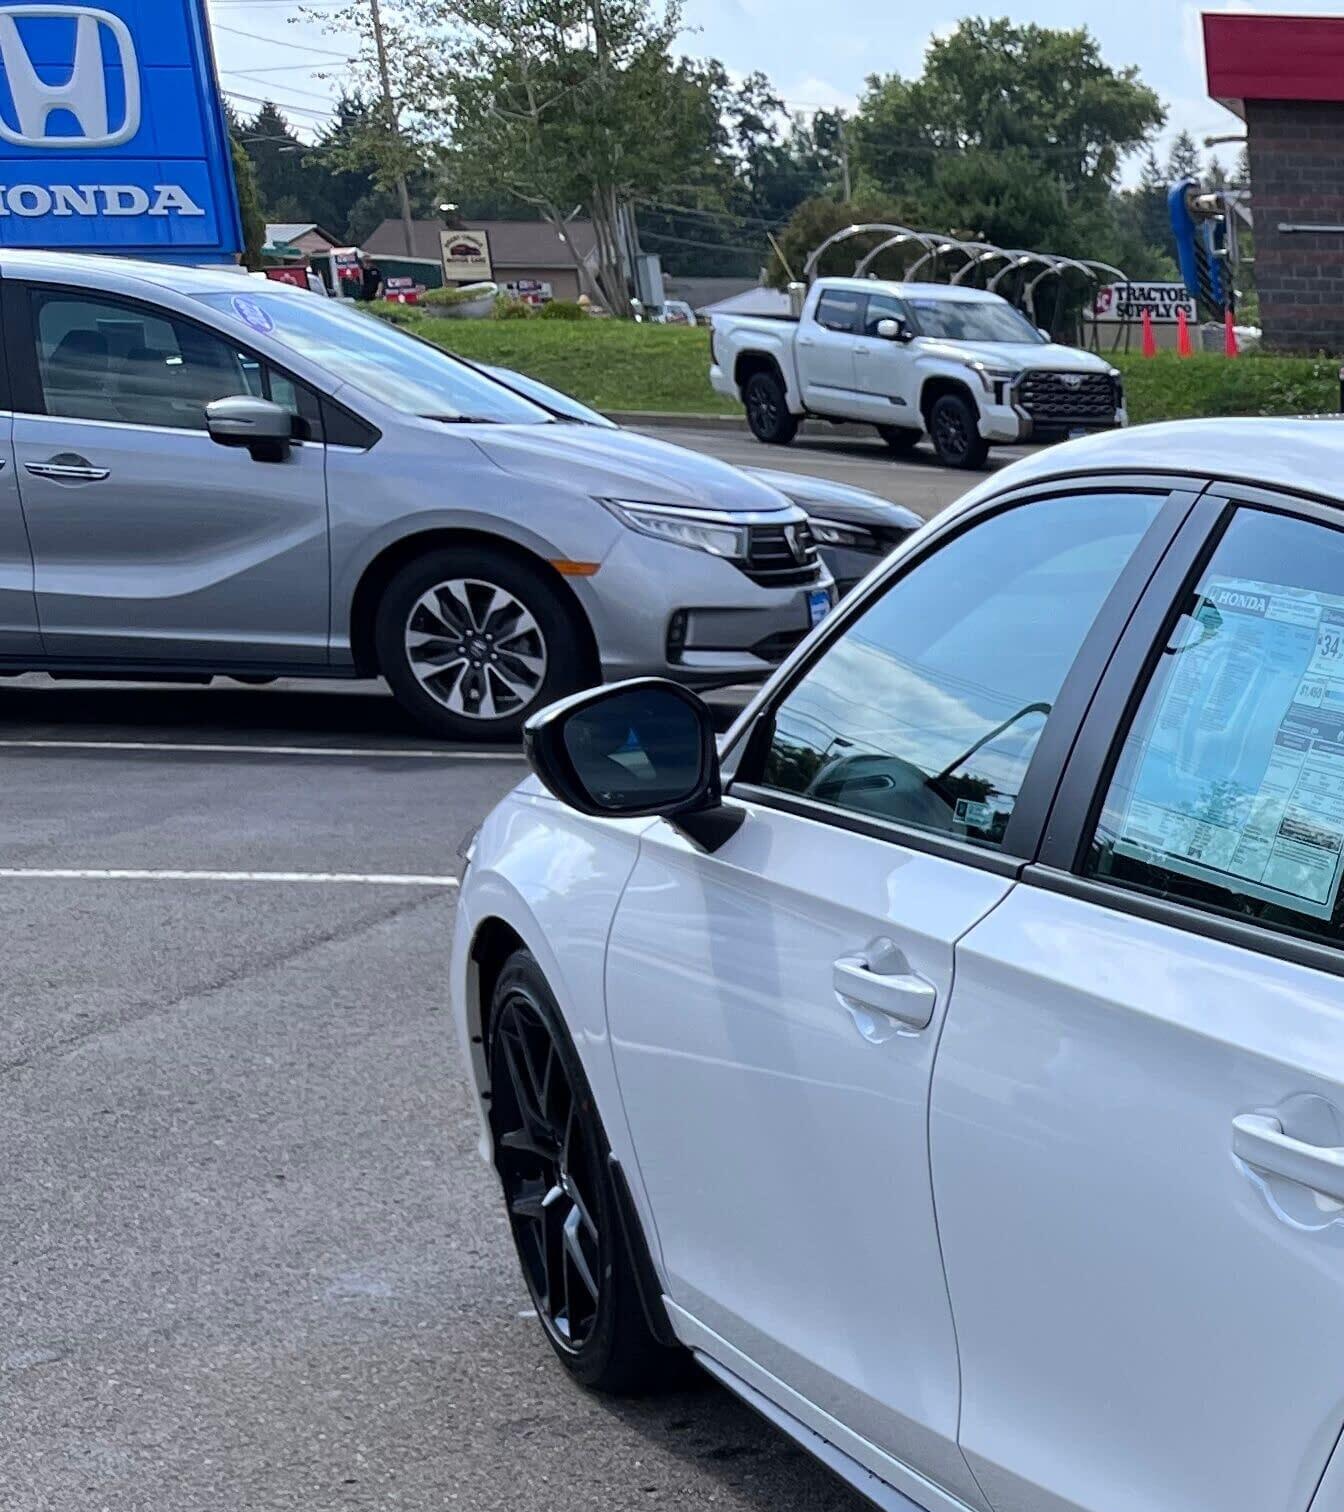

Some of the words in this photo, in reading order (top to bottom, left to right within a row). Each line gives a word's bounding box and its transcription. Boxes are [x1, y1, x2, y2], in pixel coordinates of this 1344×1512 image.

[0, 184, 205, 216] ONDA
[1116, 303, 1172, 318] SUPPLY
[1218, 591, 1266, 613] HONDA
[1321, 634, 1340, 658] 34
